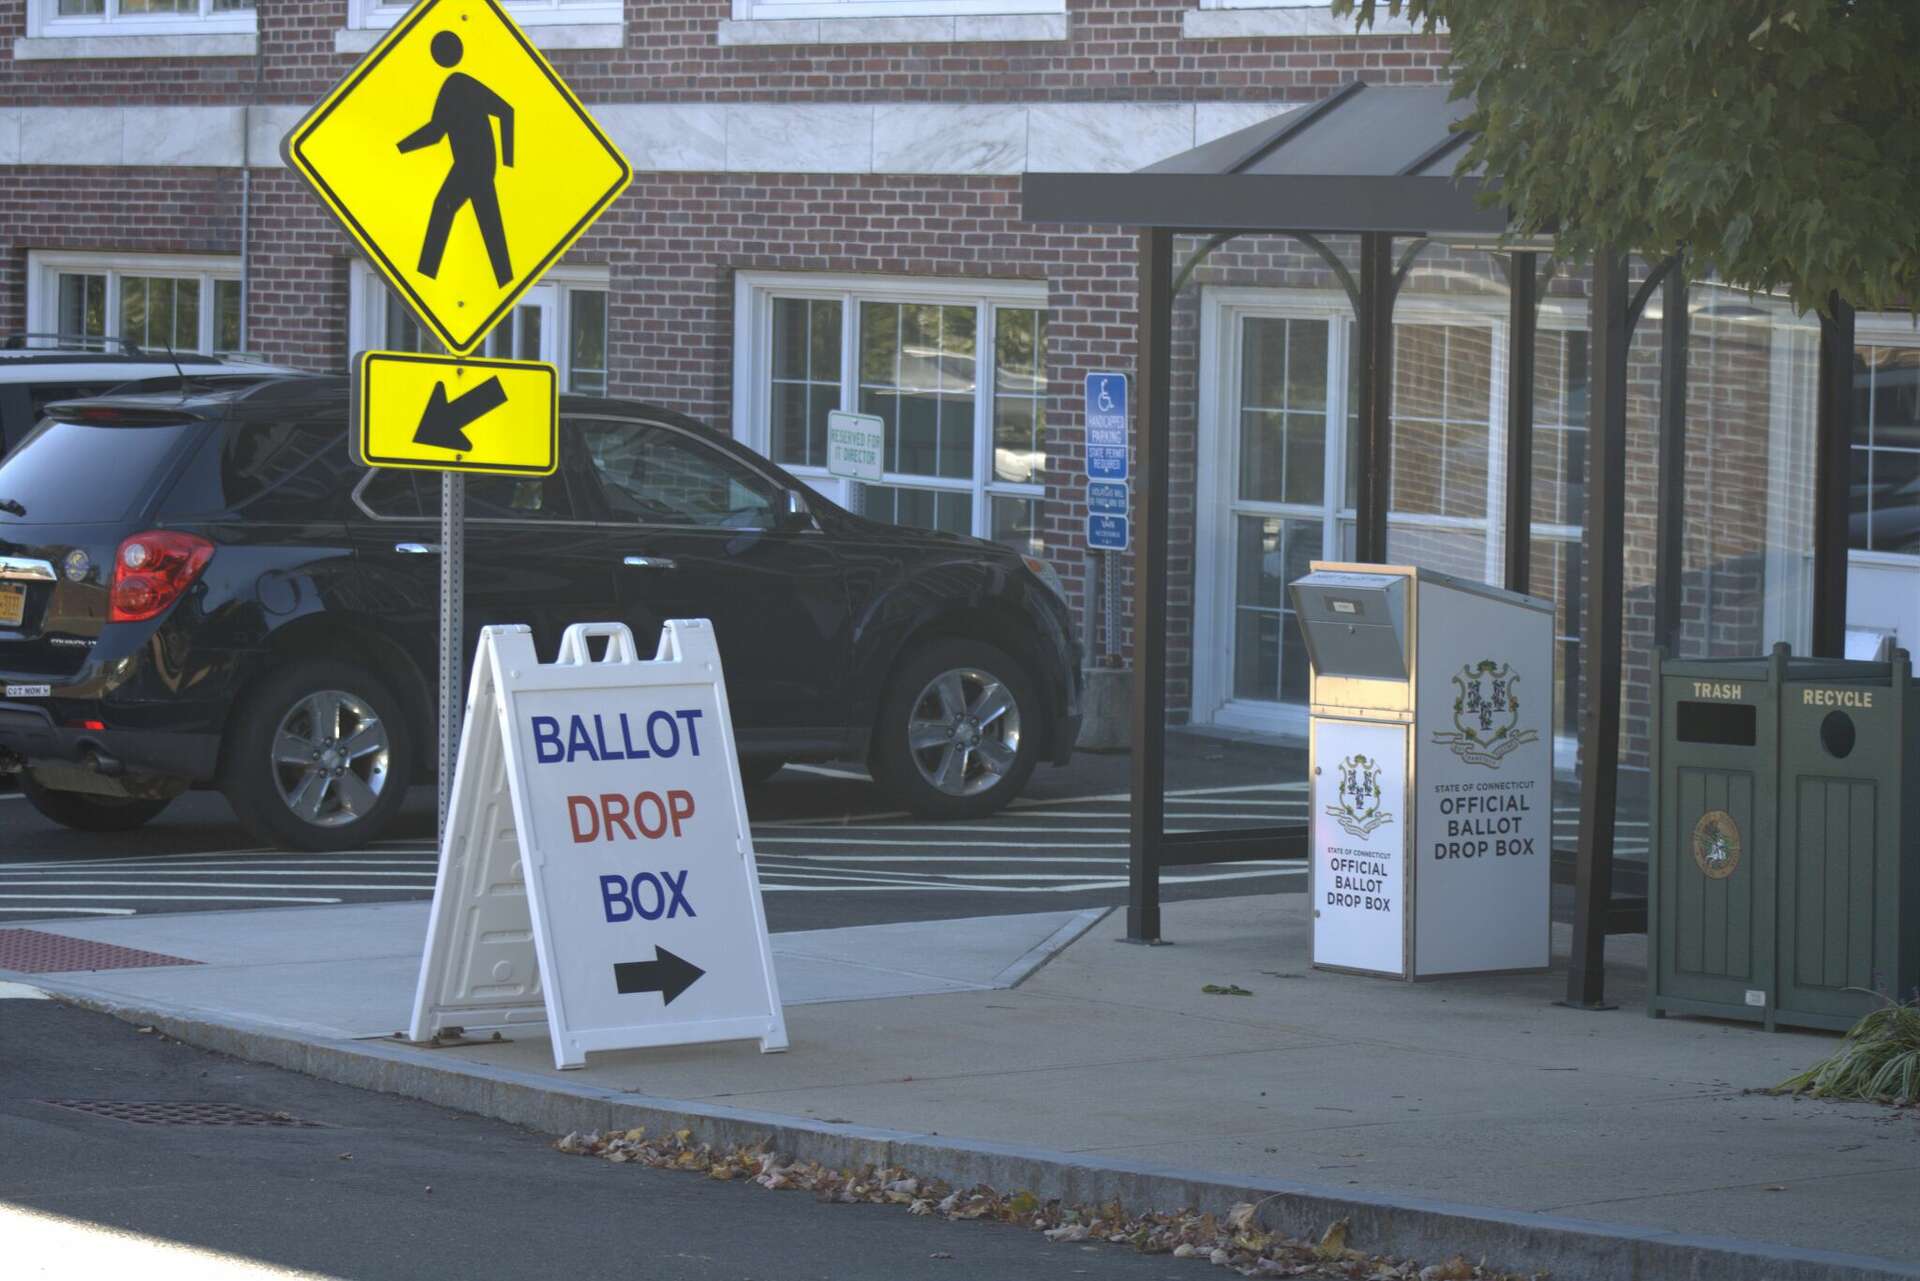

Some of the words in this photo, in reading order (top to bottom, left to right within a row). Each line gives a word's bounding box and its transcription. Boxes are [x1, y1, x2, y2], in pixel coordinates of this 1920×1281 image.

[832, 429, 865, 447] RESERVED
[867, 433, 880, 449] FOR
[1091, 430, 1121, 444] PARKING
[844, 447, 876, 465] DIRECTOR
[1088, 447, 1104, 458] STATE
[1693, 682, 1742, 700] TRASH
[1803, 689, 1872, 707] RECYCLE
[531, 710, 703, 764] BALLOT
[1435, 784, 1460, 792] STATE
[1476, 781, 1534, 791] CONNECTICUT
[1440, 795, 1530, 815] OFFICIAL
[567, 790, 695, 843] DROP
[1448, 817, 1522, 837] BALLOT
[1328, 847, 1343, 855] STATE
[1344, 848, 1352, 856] OF
[1354, 850, 1391, 859] CONNECTICUT
[1435, 841, 1488, 860] DROP
[1496, 838, 1534, 856] BOX
[1331, 858, 1388, 876] OFFICIAL
[1335, 875, 1383, 893] BALLOT
[600, 870, 697, 922] BOX
[1327, 892, 1361, 908] DROP
[1365, 896, 1391, 912] BOX
